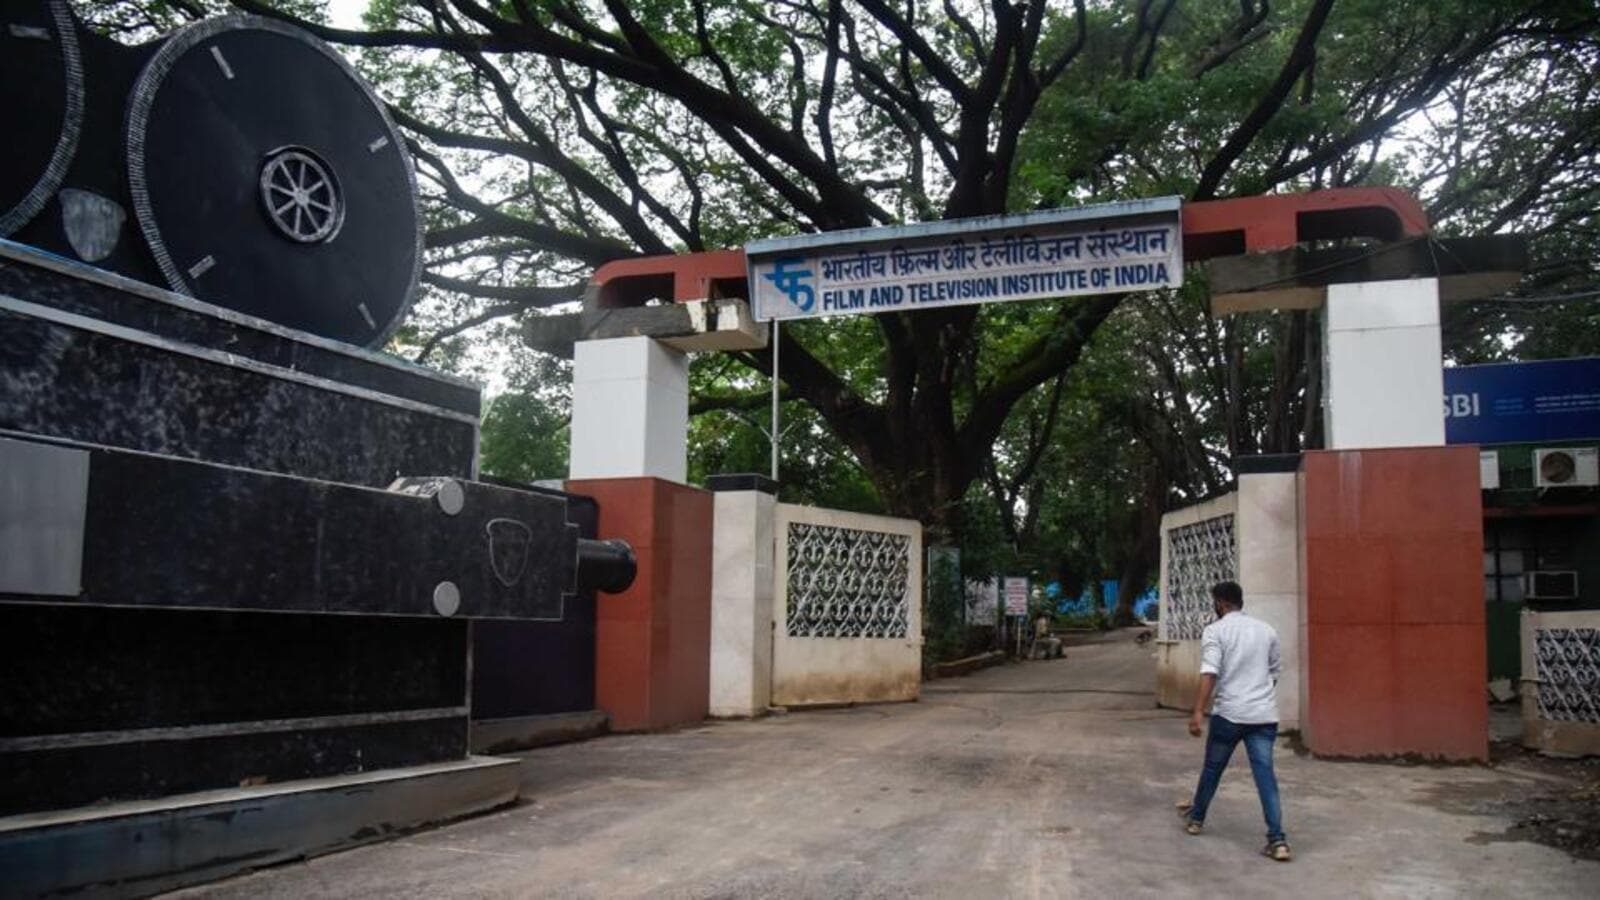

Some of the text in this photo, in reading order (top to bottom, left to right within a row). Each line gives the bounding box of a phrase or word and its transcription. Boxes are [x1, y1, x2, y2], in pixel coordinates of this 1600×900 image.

[822, 250, 886, 281] भारतीय
[942, 238, 977, 270] और
[1087, 227, 1169, 258] संस्थान
[823, 262, 1169, 311] FILM AND TELEVISION INSTITUTE OF INDIA
